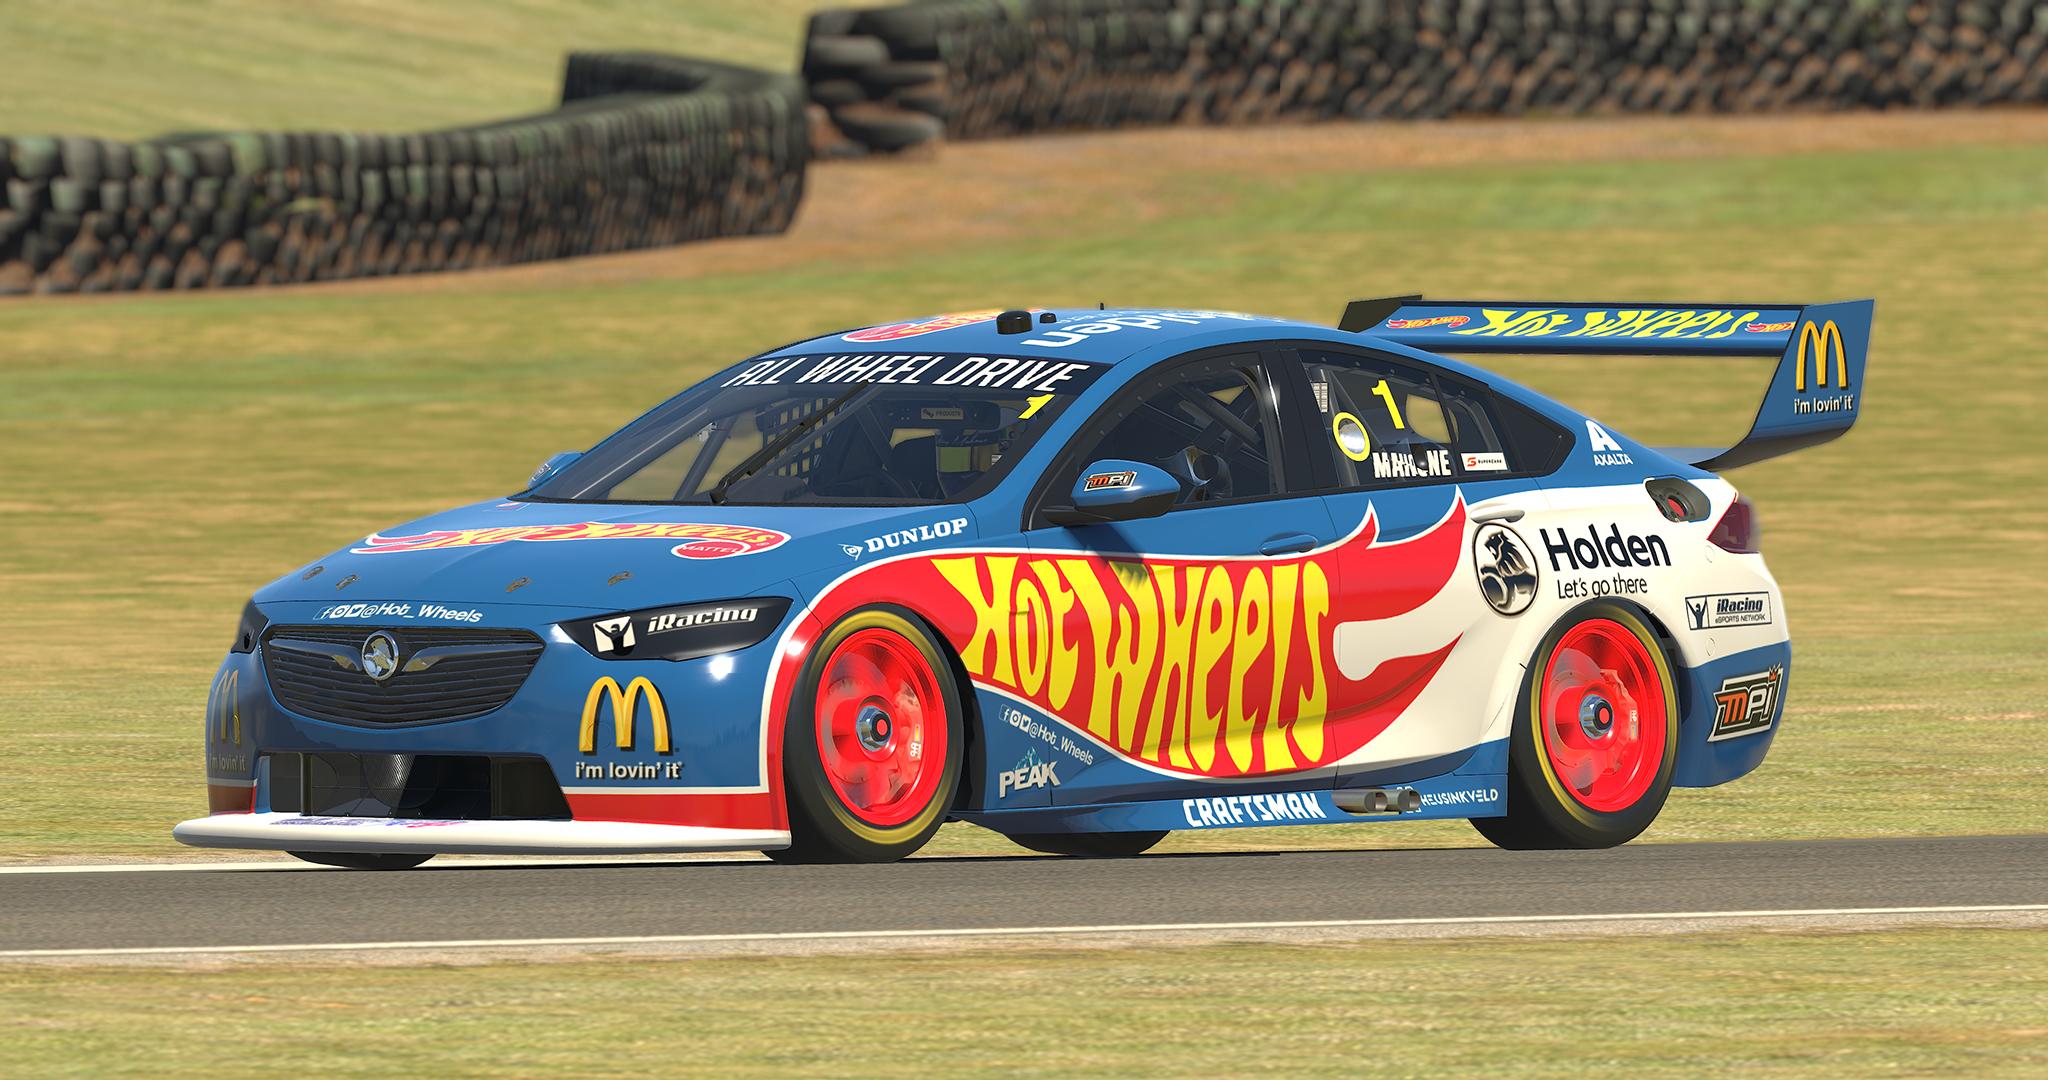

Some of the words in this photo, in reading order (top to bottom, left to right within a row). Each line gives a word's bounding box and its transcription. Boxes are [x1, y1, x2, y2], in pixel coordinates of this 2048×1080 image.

[720, 357, 807, 388] ALL
[795, 355, 945, 385] WHEEL
[932, 357, 1091, 392] DRIVE
[1018, 393, 1056, 420] 1
[1371, 379, 1405, 430] 1
[1794, 397, 1810, 415] i'm
[1372, 449, 1452, 479] MAHNE
[1593, 453, 1634, 467] AXALTA
[679, 544, 739, 553] MATTEL
[863, 517, 968, 553] DUNLOP
[1539, 522, 1672, 572] Holden
[1557, 577, 1588, 599] Let's
[1591, 579, 1611, 598] go
[1613, 572, 1648, 594] there
[1716, 597, 1763, 613] iRacing
[1740, 613, 1766, 623] NETWORK
[647, 607, 759, 634] iRacing
[575, 761, 603, 779] i'm
[609, 761, 661, 779] lovin'
[1000, 760, 1061, 799] PEAK
[1182, 793, 1327, 828] CRAFTSMAN
